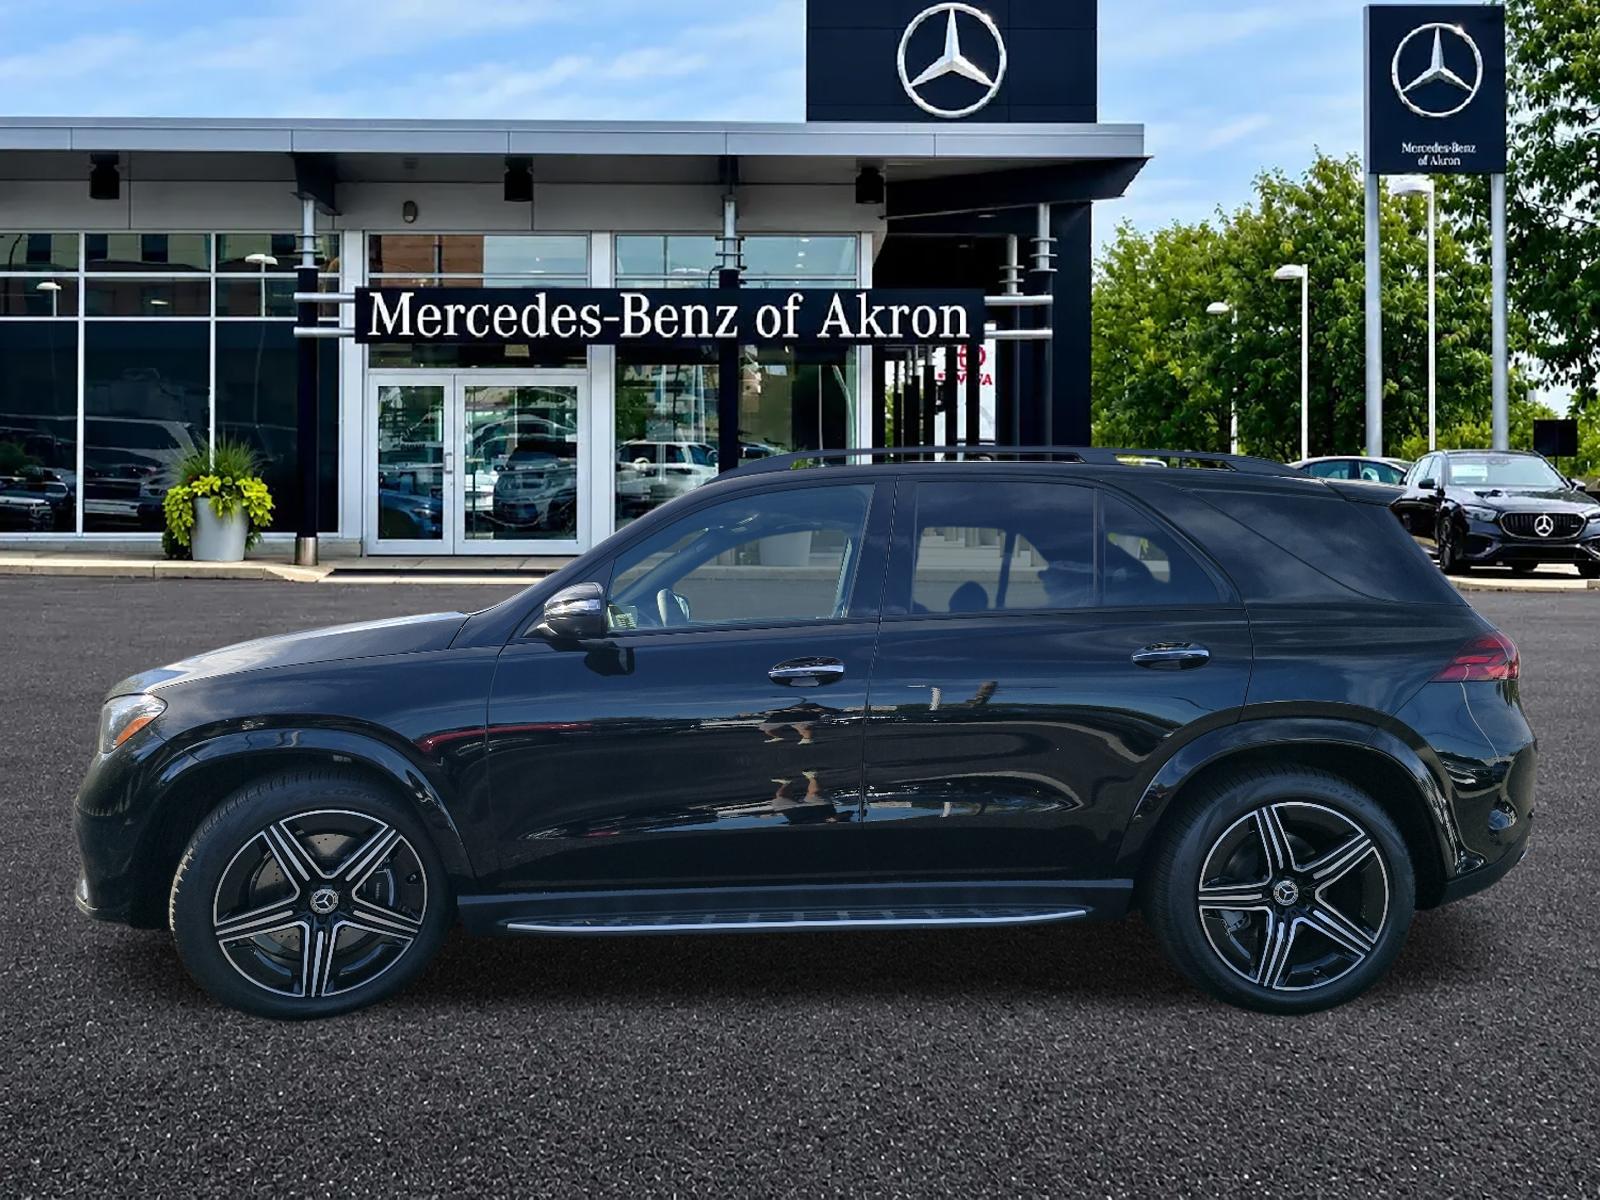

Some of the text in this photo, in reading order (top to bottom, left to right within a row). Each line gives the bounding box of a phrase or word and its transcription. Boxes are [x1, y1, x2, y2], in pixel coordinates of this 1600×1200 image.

[1401, 141, 1477, 153] Mercedes-Benz
[1417, 154, 1461, 166] of Akron
[367, 291, 970, 339] Mercedes-Benz of Akron
